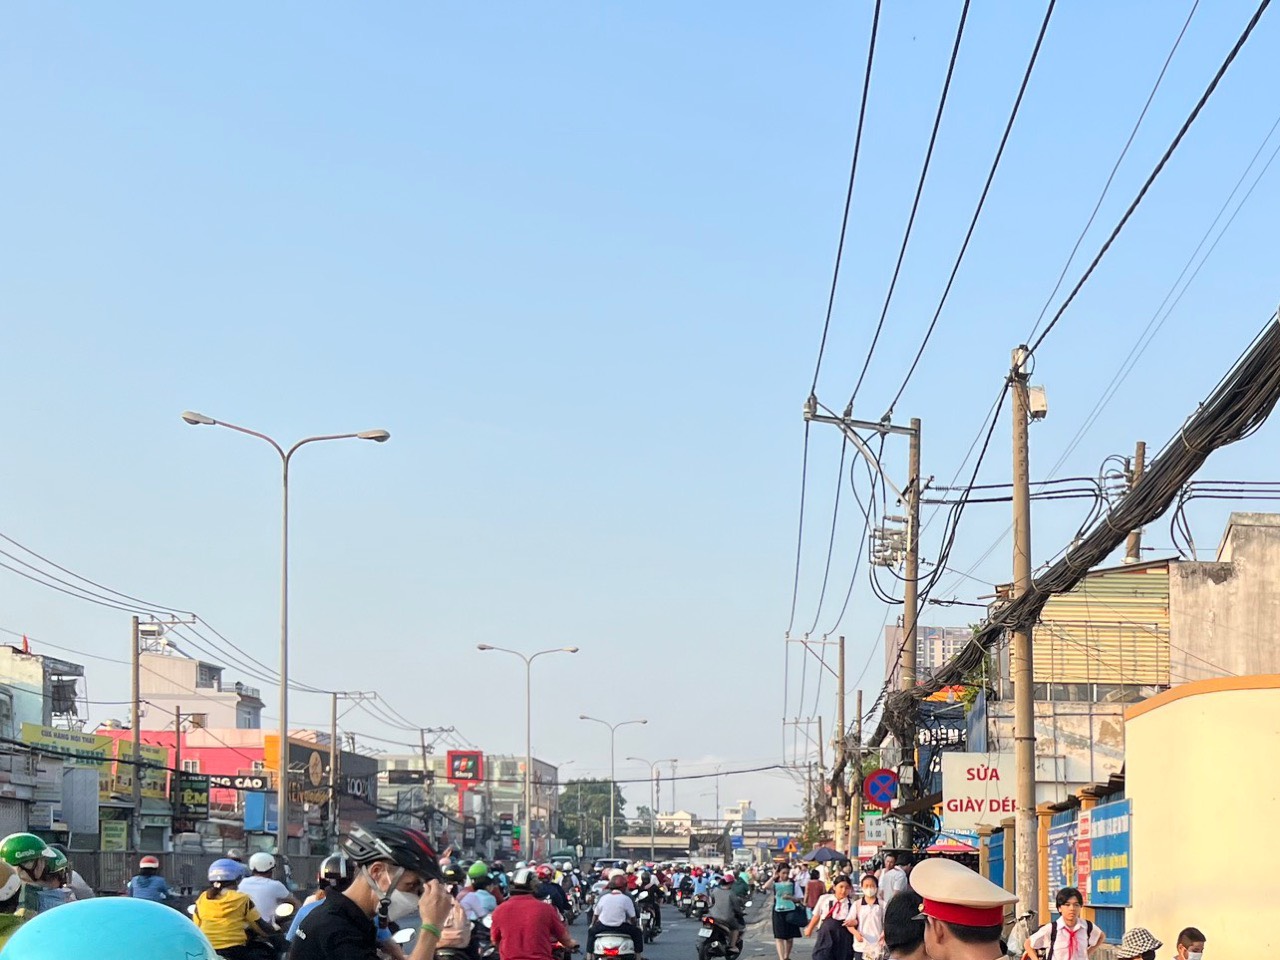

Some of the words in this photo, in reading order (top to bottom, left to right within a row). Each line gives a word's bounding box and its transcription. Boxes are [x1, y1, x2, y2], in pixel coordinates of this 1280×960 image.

[966, 763, 1000, 781] SỬA
[234, 776, 263, 788] CÁO
[947, 796, 984, 812] GIÀY
